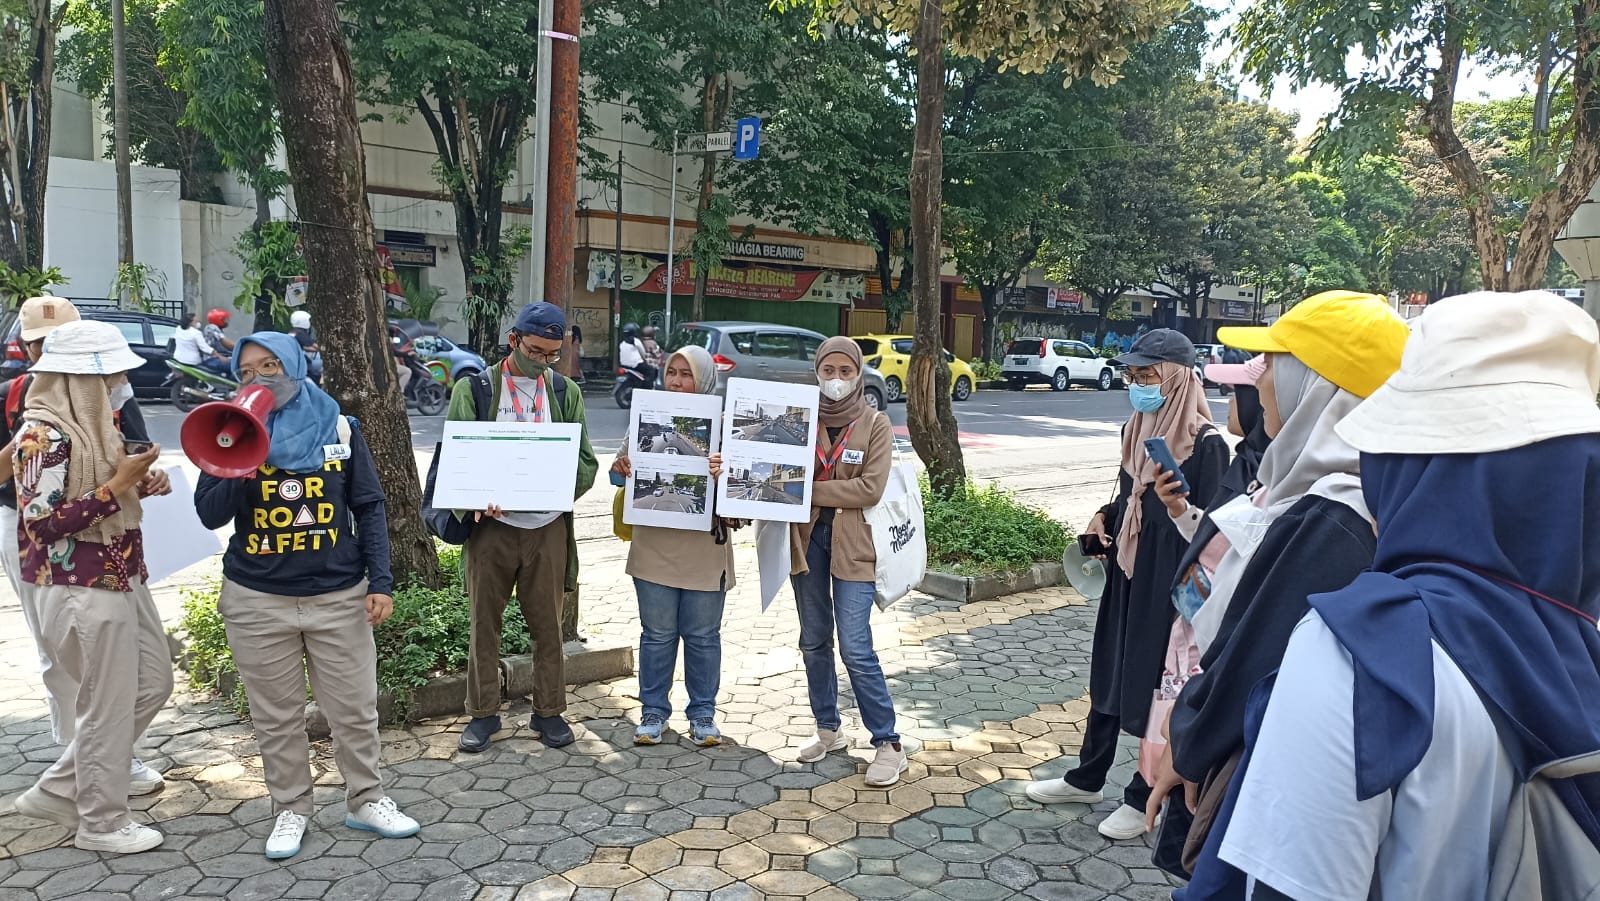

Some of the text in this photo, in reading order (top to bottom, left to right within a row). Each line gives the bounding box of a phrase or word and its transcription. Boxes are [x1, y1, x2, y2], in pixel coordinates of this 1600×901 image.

[707, 137, 730, 147] PARALEL
[740, 124, 755, 153] P
[762, 245, 804, 260] BEARING
[746, 268, 796, 288] BEARING
